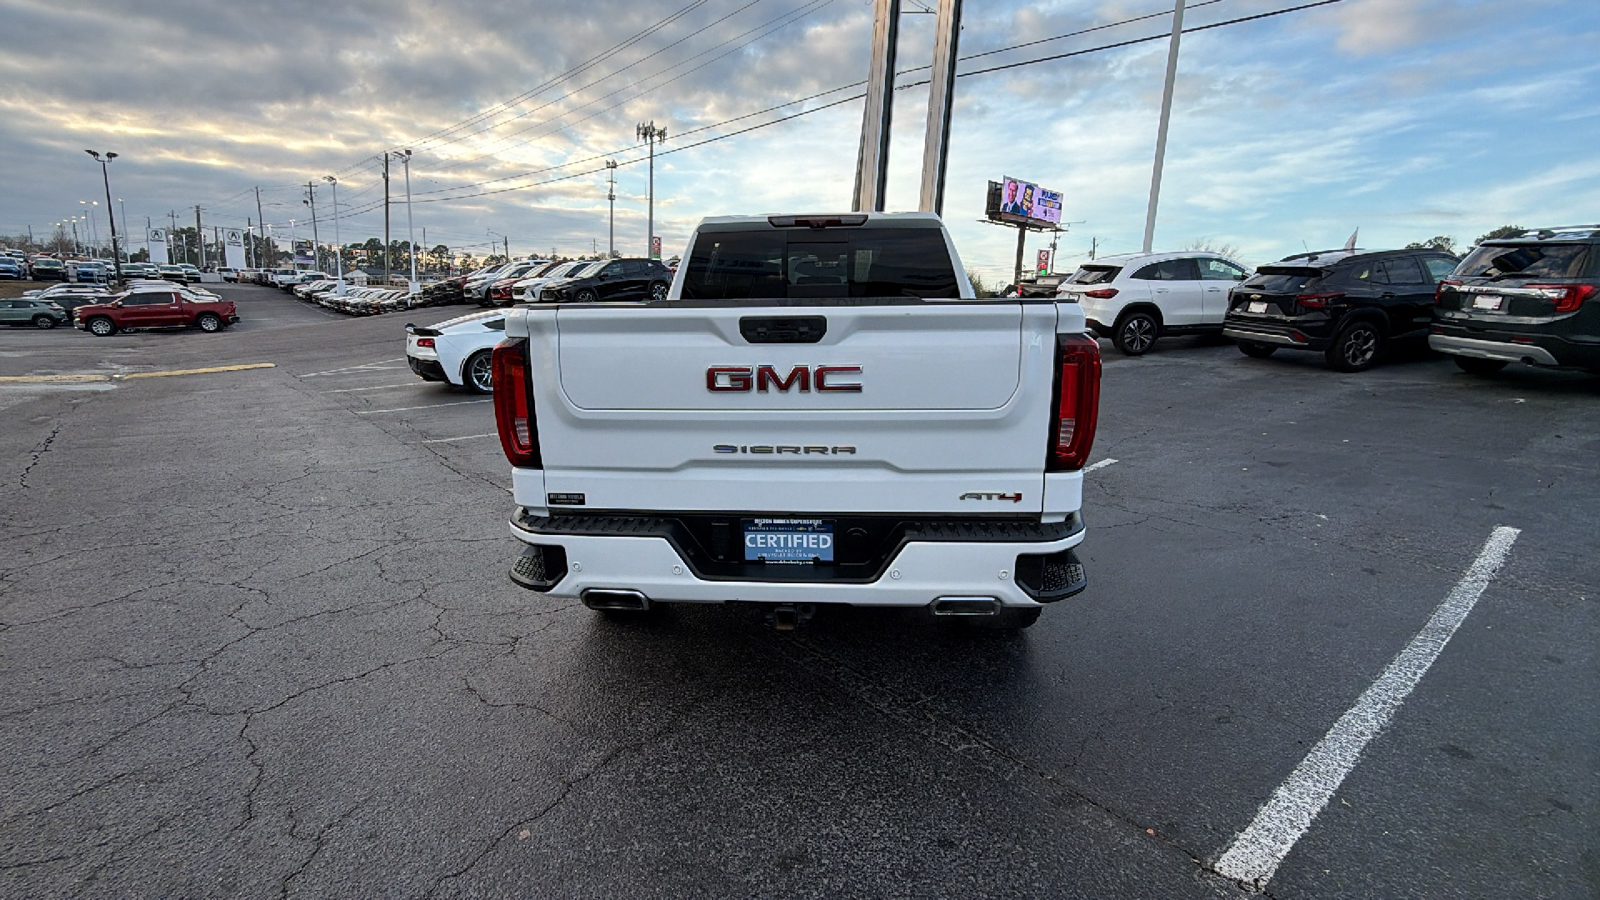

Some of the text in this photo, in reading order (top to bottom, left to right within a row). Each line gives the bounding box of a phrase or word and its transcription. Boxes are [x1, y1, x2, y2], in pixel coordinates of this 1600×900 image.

[706, 364, 864, 394] GMC
[712, 444, 857, 455] SIERRA
[959, 492, 1022, 504] AT4
[745, 534, 832, 549] CERTIFIED
